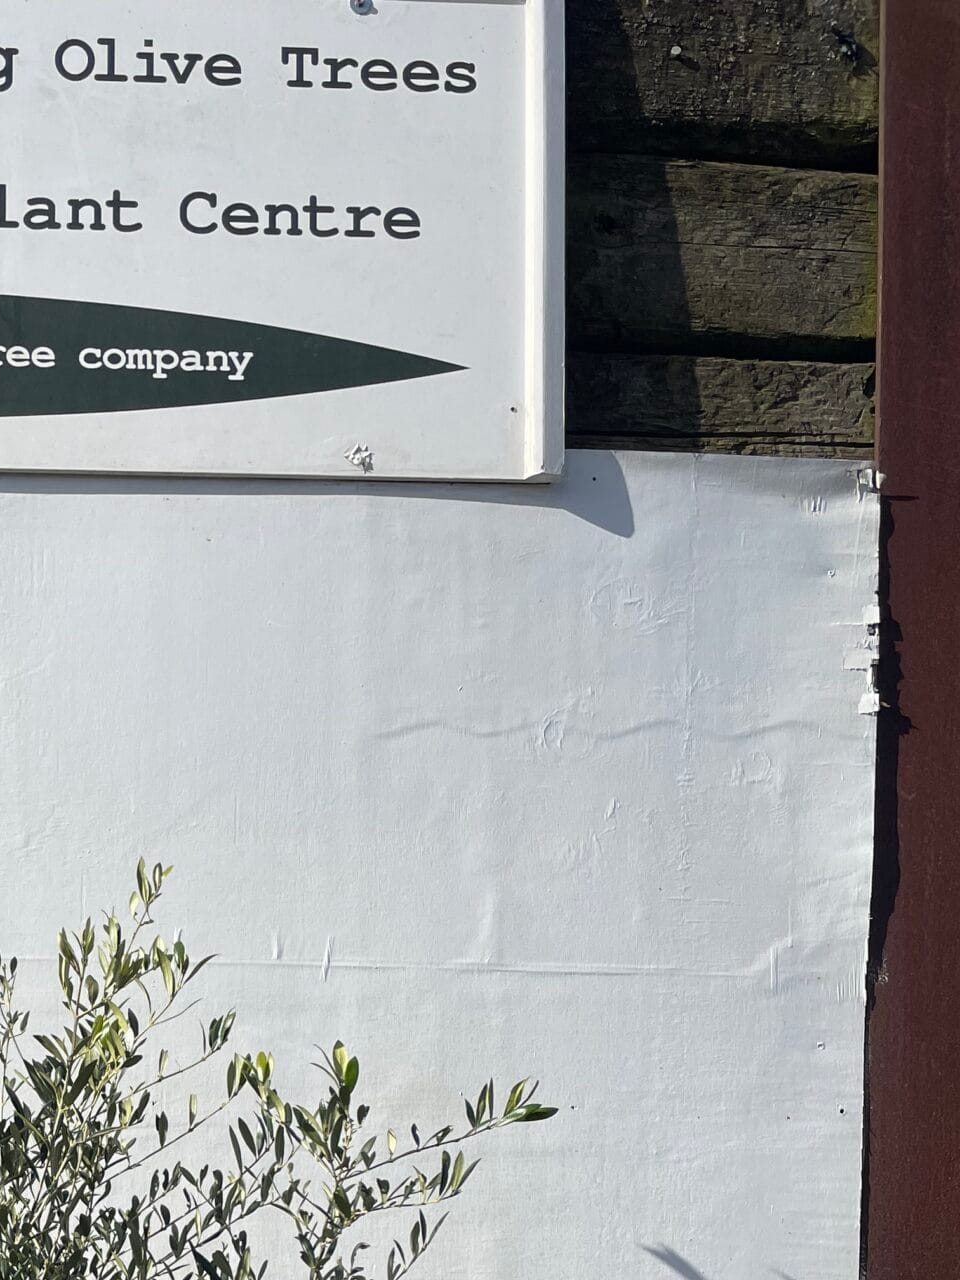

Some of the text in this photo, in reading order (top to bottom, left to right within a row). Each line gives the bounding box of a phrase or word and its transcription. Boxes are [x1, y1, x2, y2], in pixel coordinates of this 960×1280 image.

[54, 37, 242, 87] Olive
[281, 46, 477, 94] Trees
[179, 191, 422, 240] Centre
[78, 347, 254, 381] company
